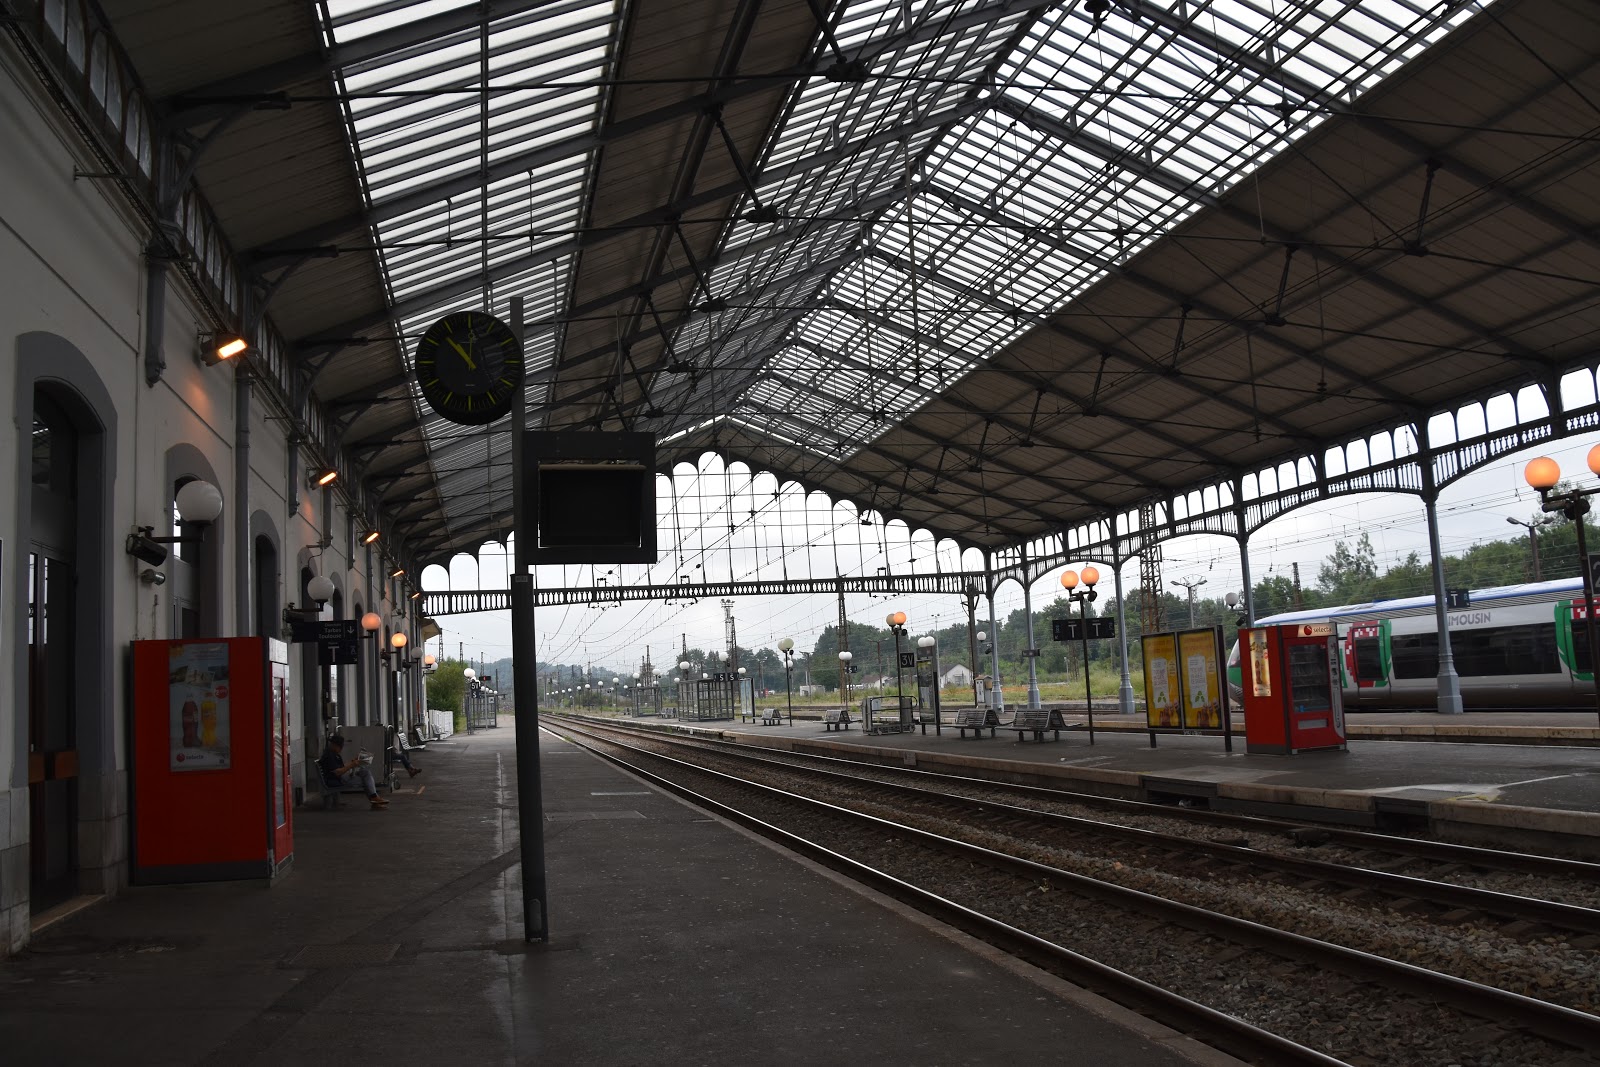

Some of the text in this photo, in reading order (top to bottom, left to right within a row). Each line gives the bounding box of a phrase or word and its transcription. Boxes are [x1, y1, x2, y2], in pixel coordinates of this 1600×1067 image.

[1448, 612, 1491, 626] IMOUSIN
[1067, 624, 1077, 638] T
[1092, 623, 1101, 636] T
[328, 646, 340, 662] T
[901, 655, 914, 665] 3V
